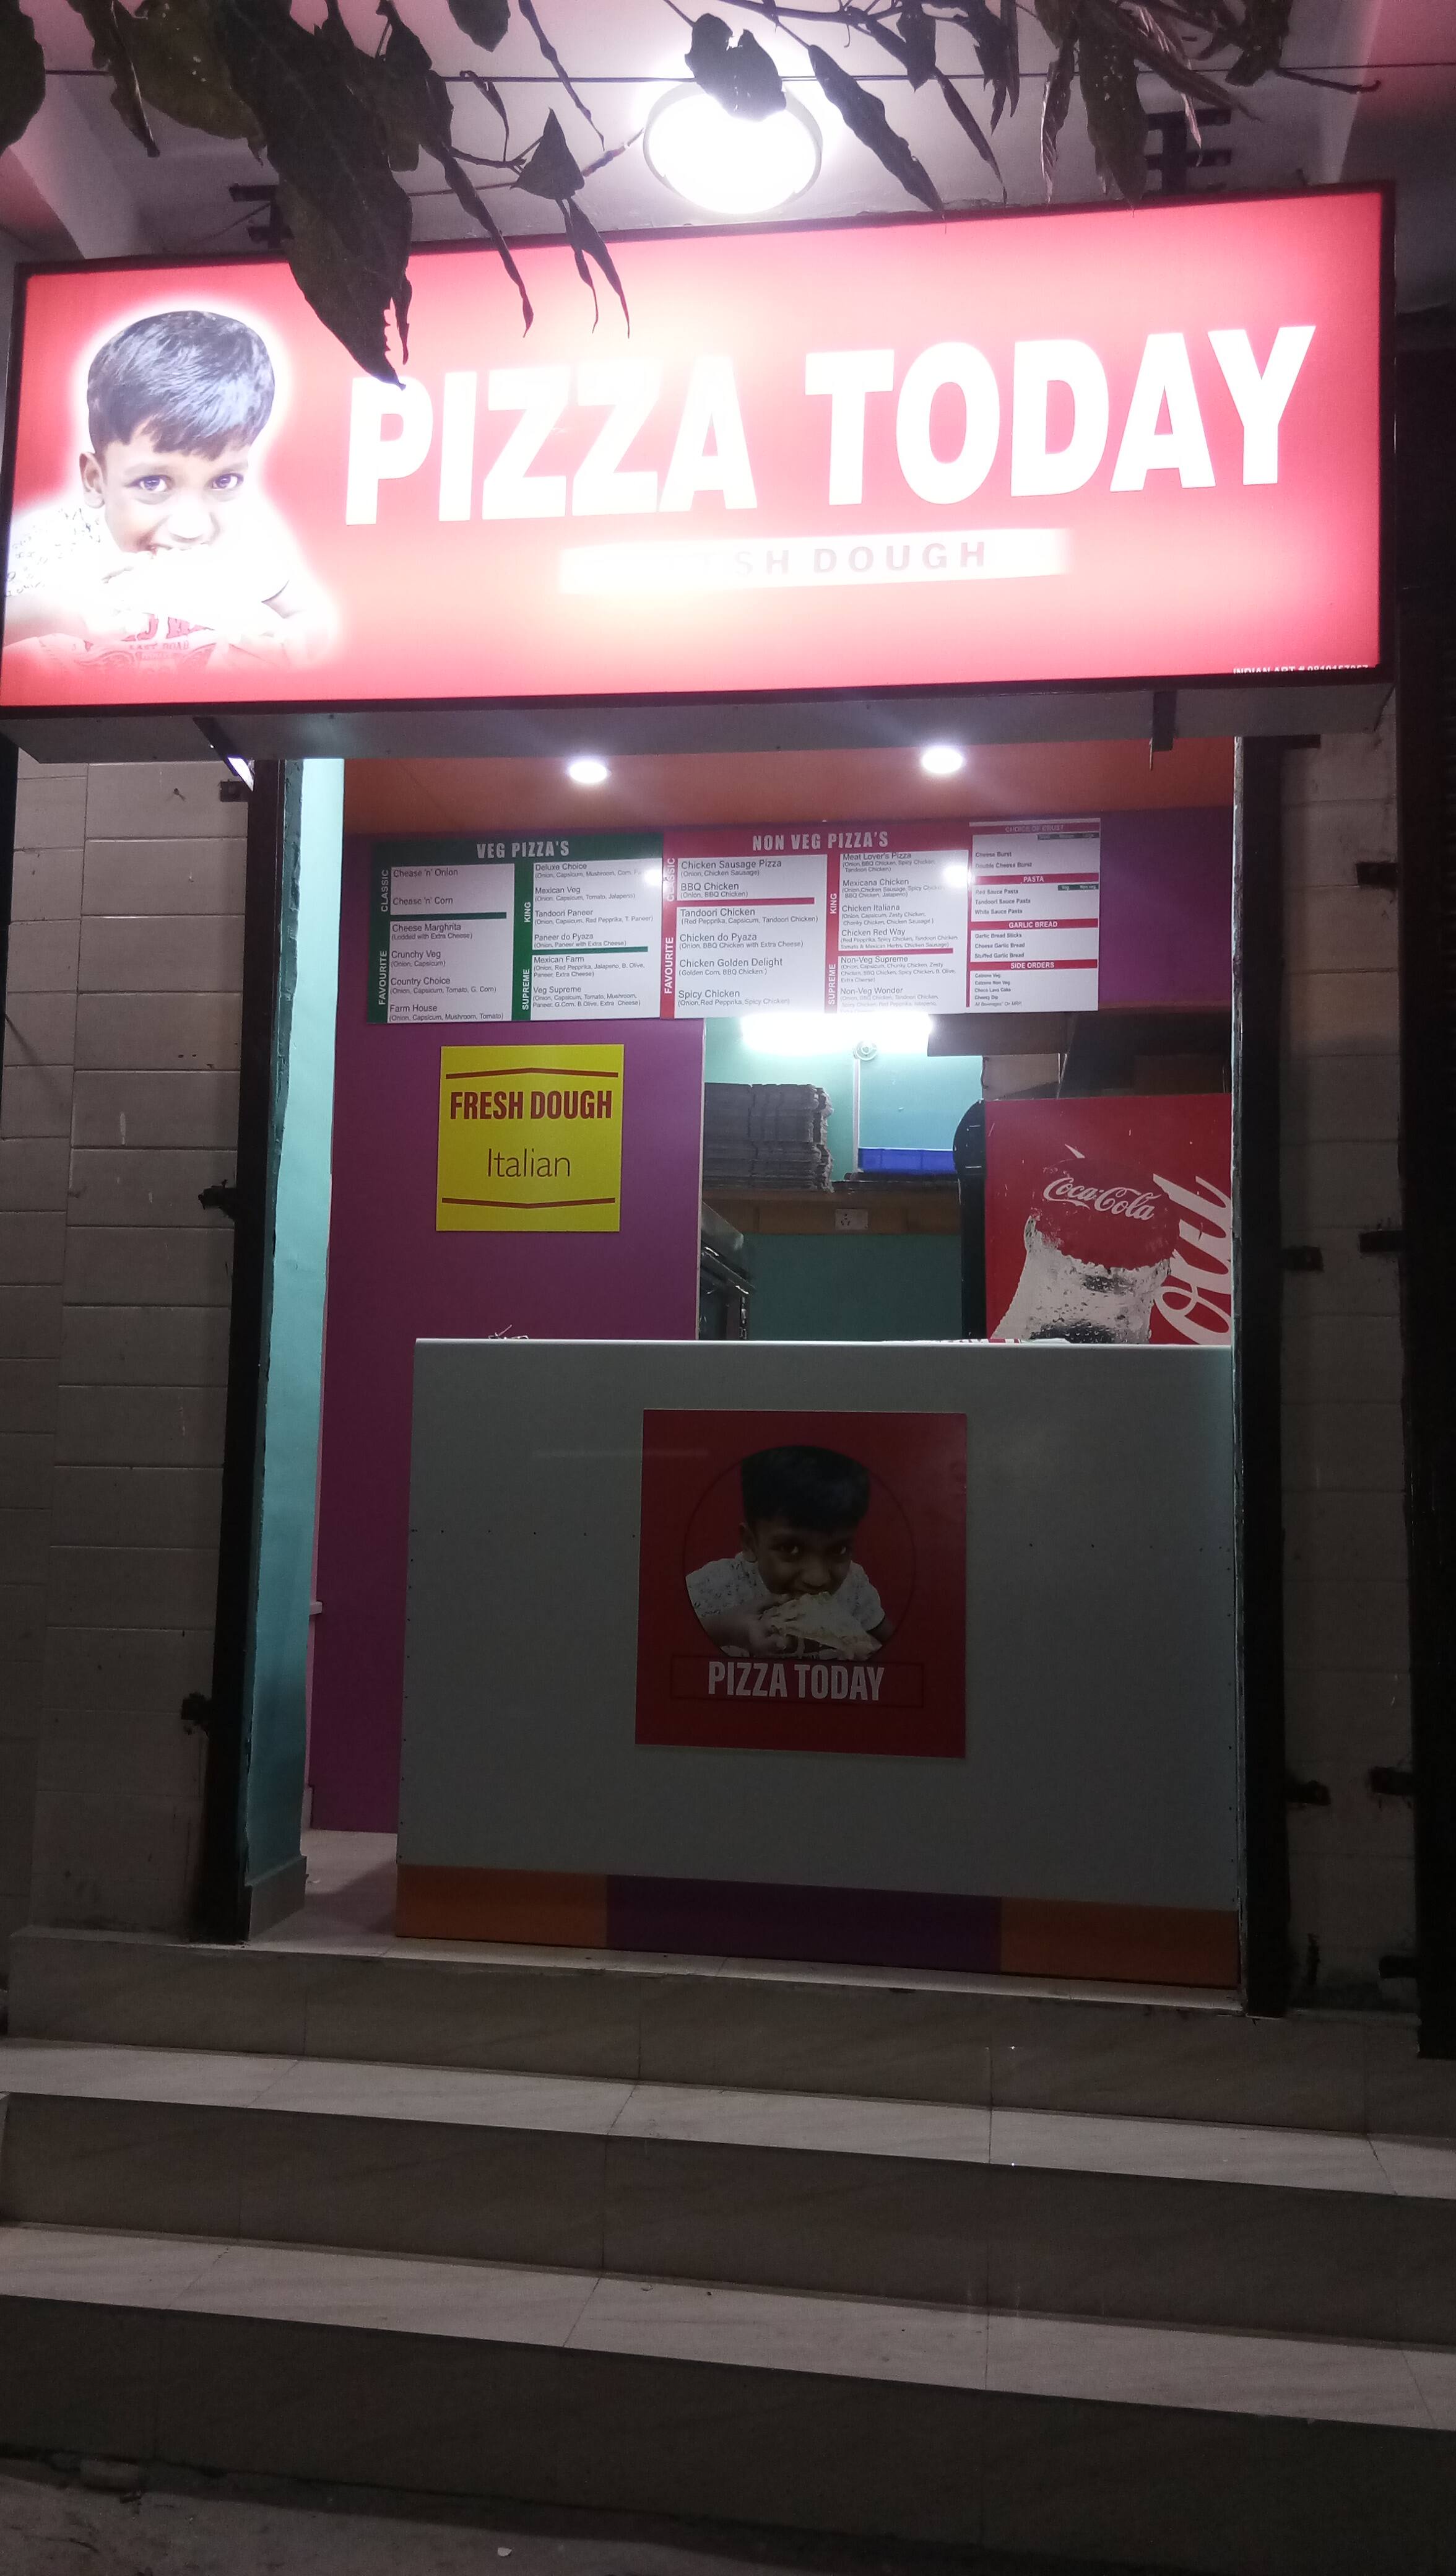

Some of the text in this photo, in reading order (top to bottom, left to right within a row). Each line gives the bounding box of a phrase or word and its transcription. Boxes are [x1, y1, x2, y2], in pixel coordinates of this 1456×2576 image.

[345, 325, 1316, 525] PIZZA TODAY
[813, 541, 986, 573] DOUGH
[753, 831, 888, 851] NON VEG PIZZA'S
[477, 840, 569, 858] VEG PIZZA'S
[863, 852, 890, 860] Lover's
[535, 863, 560, 871] Deluxe
[681, 859, 782, 870] Chicken Sausage Pizza
[435, 867, 458, 876] Onion
[381, 869, 389, 912] CLASSIC
[535, 886, 581, 894] Mexican Veg
[681, 882, 739, 891] BBQ Chicken
[535, 910, 565, 918] Tandoori
[681, 907, 755, 916] Tandoori Chicken
[791, 915, 818, 923] Chicken)
[392, 923, 461, 933] Cheese Marghrita
[890, 928, 906, 936] Way
[534, 933, 559, 941] Paneer
[573, 933, 593, 941] Pyaza
[680, 933, 757, 943] Chicken do Pyaza
[391, 949, 441, 959] Crunchy Veg
[680, 957, 783, 967] Chicken Golden Delight
[875, 955, 908, 964] Supreme
[664, 937, 674, 994] FAVOURITE
[378, 951, 387, 1005] FAVOURITE
[391, 977, 450, 986] Country Choice
[522, 968, 530, 1010] SUPREME
[533, 986, 581, 994] Veg Supreme
[678, 990, 740, 999] Spicy Chicken
[390, 1004, 410, 1012] Farm
[450, 1090, 612, 1120] FRESH DOUGH
[488, 1148, 570, 1177] Italian
[1043, 1177, 1161, 1221] Coca-Cola
[708, 1661, 885, 1701] PIZZA TODAY
